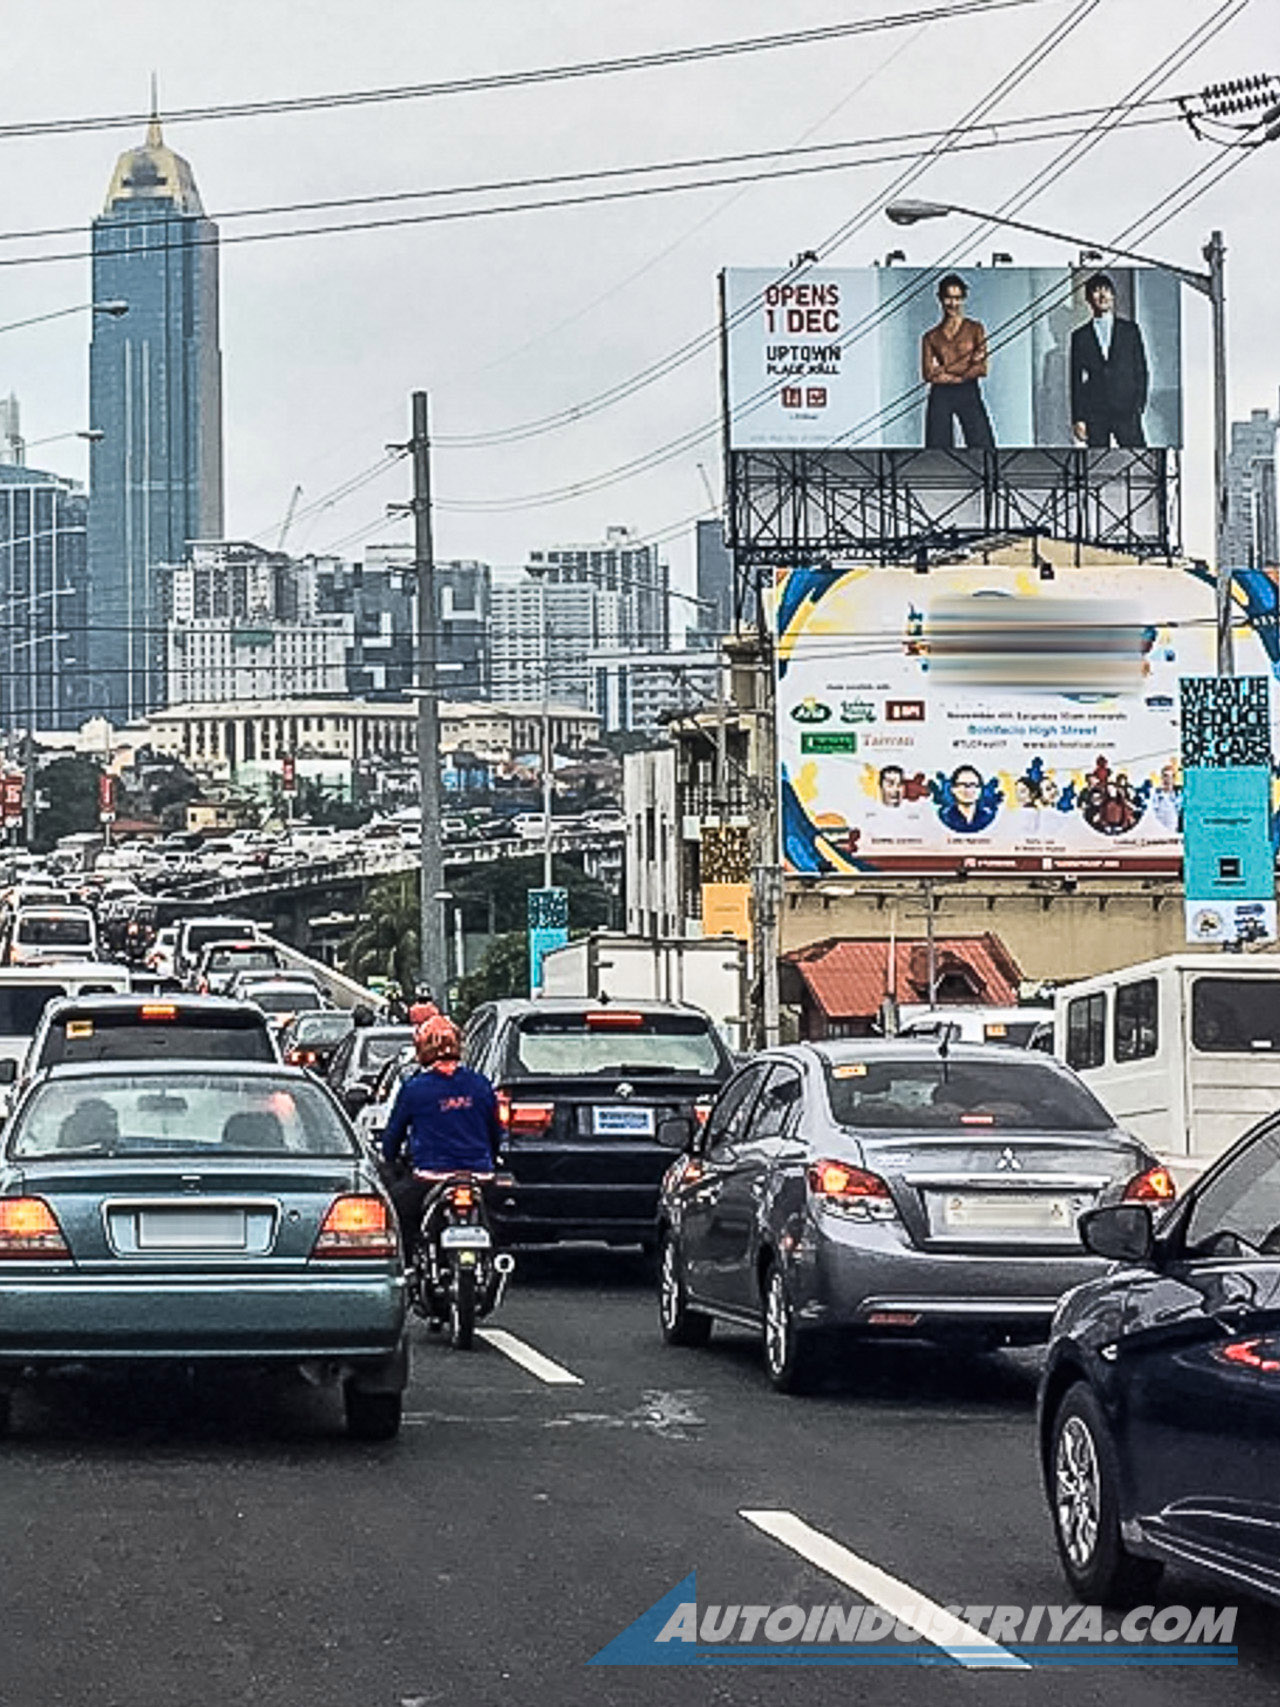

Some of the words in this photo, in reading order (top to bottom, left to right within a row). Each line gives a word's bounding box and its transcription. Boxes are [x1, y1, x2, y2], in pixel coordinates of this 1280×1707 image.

[766, 284, 839, 307] OPENS
[766, 309, 775, 333] 1
[788, 309, 840, 333] DEC
[767, 345, 841, 361] UPTOWN
[767, 363, 803, 375] PLACE
[967, 725, 1026, 735] Bonifacio
[1029, 725, 1058, 738] High
[1061, 725, 1098, 735] Street
